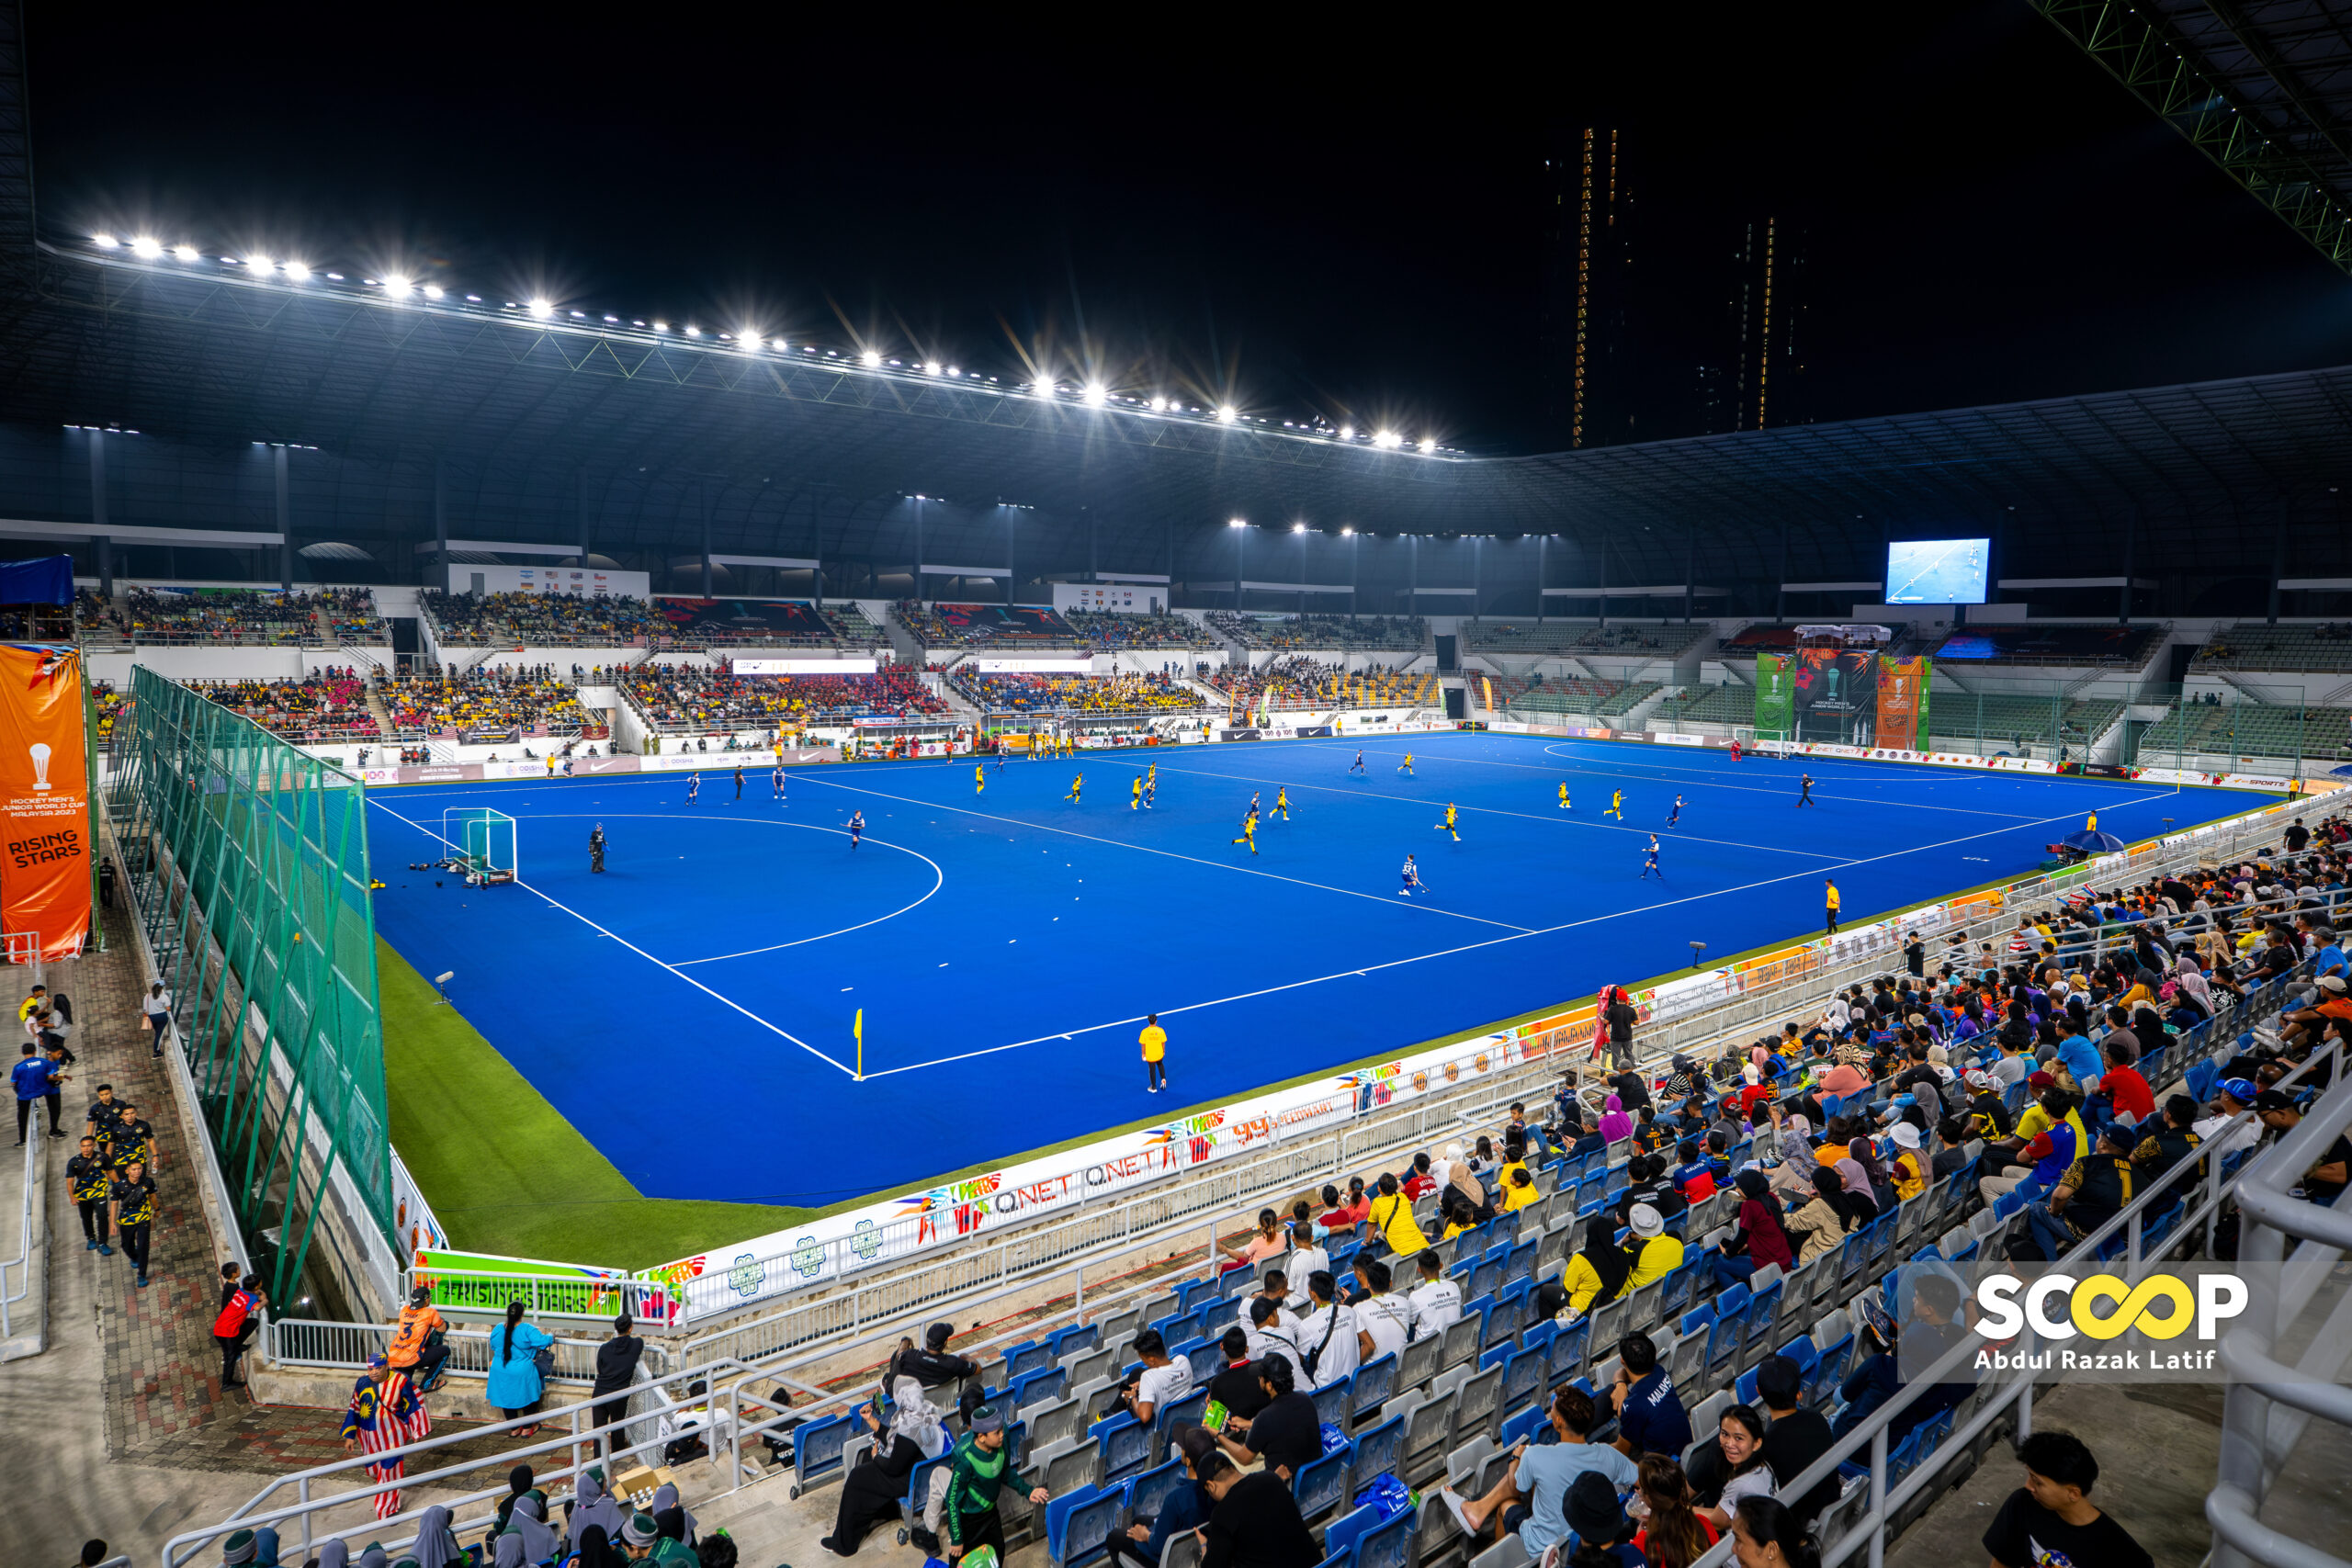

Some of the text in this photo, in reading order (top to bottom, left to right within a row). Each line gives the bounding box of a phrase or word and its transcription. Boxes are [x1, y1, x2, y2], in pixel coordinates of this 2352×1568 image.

[2249, 779, 2286, 787] SPORTS
[8, 829, 77, 855] RISING
[15, 843, 81, 868] STARS
[2185, 1134, 2199, 1143] FAN
[1684, 1161, 1705, 1173] MALAYSIA
[2113, 1157, 2132, 1171] FAN
[995, 1150, 1154, 1213] QNET QNET
[444, 1283, 587, 1314] #RISINGSTARS
[399, 1322, 414, 1341] 3
